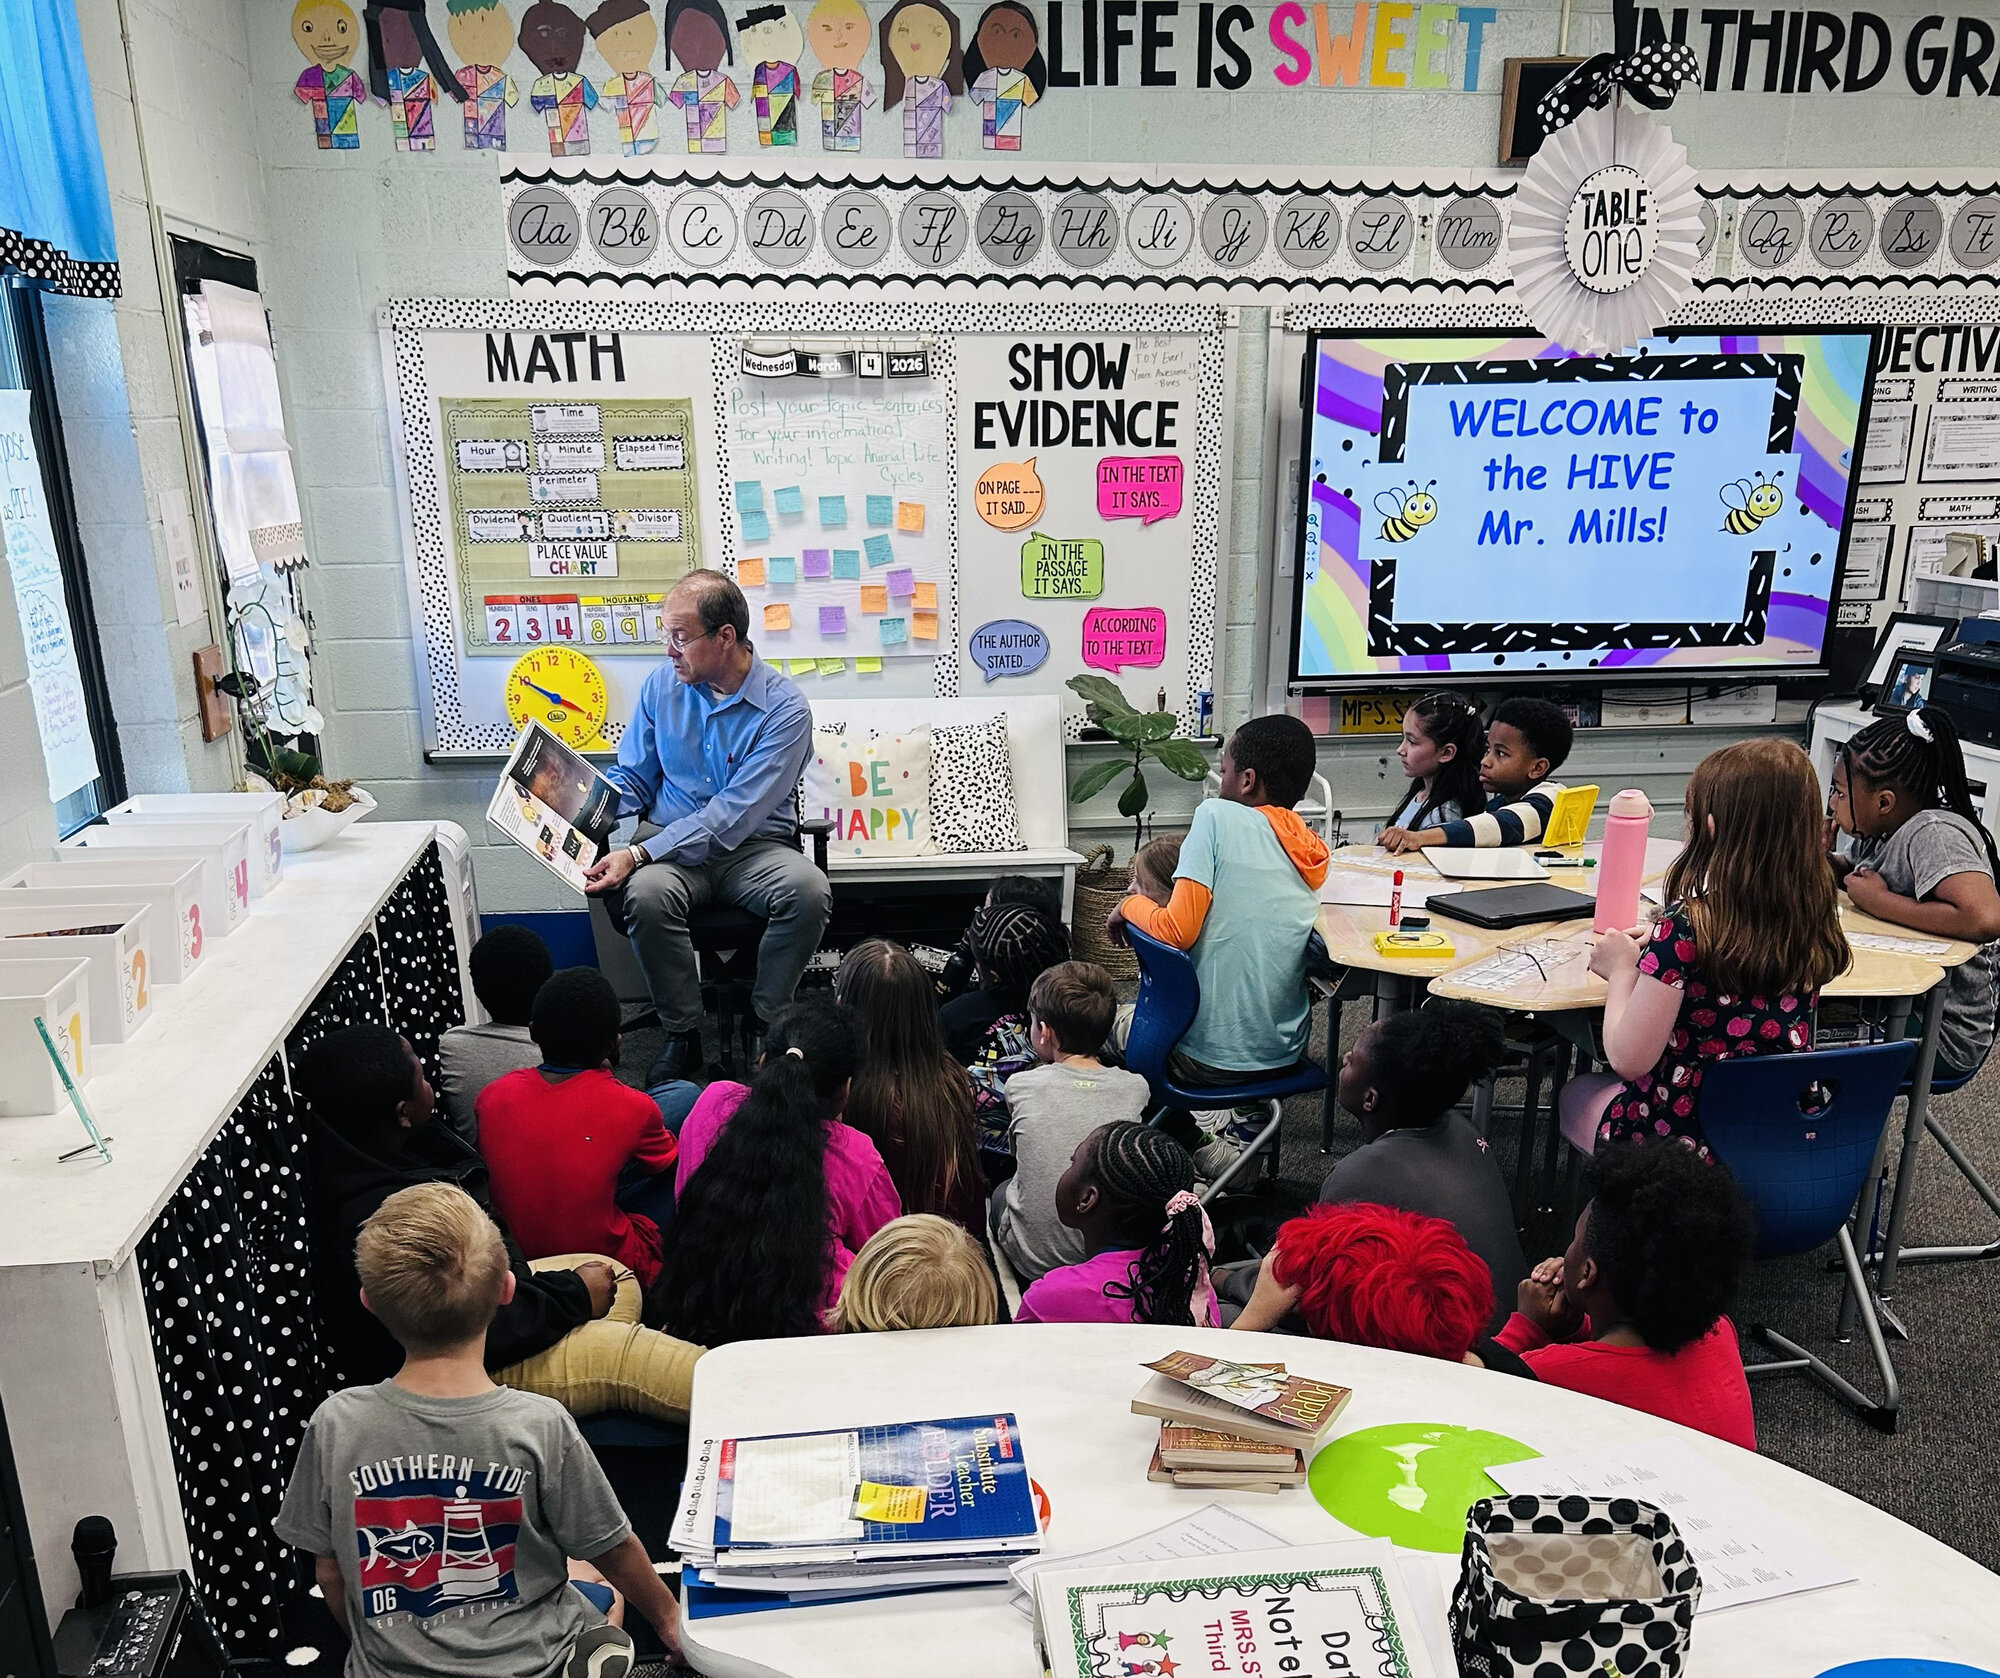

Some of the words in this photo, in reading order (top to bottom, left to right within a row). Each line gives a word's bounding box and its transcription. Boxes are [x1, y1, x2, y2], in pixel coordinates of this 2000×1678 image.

[1047, 1, 1179, 88] LIFE
[1197, 2, 1255, 90] IS
[1268, 1, 1497, 92] SWEET
[1700, 9, 1892, 94] THIRD
[1581, 188, 1648, 230] TABLE
[518, 205, 571, 247] Aa
[598, 205, 651, 248] Bb
[682, 206, 722, 248] Cc
[752, 208, 806, 249] Dd
[837, 207, 877, 249] Ee
[913, 206, 958, 263] Ff
[980, 208, 1037, 261] Gg
[1060, 208, 1109, 250] Hh
[1137, 208, 1179, 250] Ii
[1218, 208, 1254, 261] Jj
[1284, 208, 1330, 250] Kk
[1356, 208, 1403, 250] Ll
[1441, 211, 1498, 249] Mm
[1748, 210, 1792, 263] Qq
[1818, 212, 1862, 251] Rr
[1887, 211, 1930, 253] Ss
[1965, 214, 1997, 252] Tt
[1582, 226, 1643, 277] one
[485, 332, 626, 383] MATH
[744, 357, 795, 374] Wednesday
[808, 359, 842, 372] March
[867, 358, 875, 371] 4
[890, 358, 925, 372] 2026
[1008, 341, 1131, 391] SHOW
[1873, 325, 2000, 374] JECTIV
[1962, 386, 1998, 394] WRITING
[560, 407, 584, 417] Time
[731, 387, 769, 417] Post
[776, 398, 820, 429] your
[823, 389, 868, 430] topic
[974, 399, 1180, 450] EVIDENCE
[1449, 396, 1663, 439] WELCOME
[1680, 400, 1719, 435] to
[471, 446, 496, 455] Hour
[559, 444, 593, 454] Minute
[618, 444, 656, 453] Elapsed
[658, 442, 680, 451] Time
[735, 420, 759, 442] for
[768, 428, 798, 454] your
[820, 445, 856, 474] Topic
[864, 442, 908, 466] Animal
[1102, 467, 1119, 484] IN
[1121, 466, 1146, 483] THE
[1148, 465, 1179, 483] TEXT
[1483, 457, 1547, 492] the
[1567, 451, 1676, 492] HIVE
[539, 476, 588, 485] Perimeter
[880, 466, 925, 490] Cycles
[979, 481, 995, 494] ON
[996, 481, 1021, 495] PAGE
[986, 501, 999, 515] IT
[1112, 492, 1128, 509] IT
[1853, 506, 1869, 515] ISH
[1949, 504, 1972, 513] MATH
[473, 515, 516, 524] Dividend
[548, 513, 593, 523] Quotient
[637, 513, 673, 522] Divisor
[1477, 509, 1545, 547] Mr.
[1568, 505, 1667, 544] Mills!
[537, 545, 571, 559] PLACE
[575, 545, 608, 559] VALUE
[550, 561, 597, 575] CHART
[1041, 544, 1059, 560] IN
[1061, 543, 1084, 560] THE
[1036, 560, 1088, 577] PASSAGE
[602, 595, 650, 604] THOUSANDS
[1034, 578, 1050, 594] IT
[495, 618, 511, 642] 2
[526, 617, 542, 641] 3
[556, 616, 574, 640] 4
[620, 617, 638, 640] 9
[1092, 617, 1157, 634] ACCORDING
[1837, 608, 1857, 619] lies
[591, 619, 606, 642] 8
[978, 635, 998, 649] THE
[1000, 633, 1040, 649] AUTHOR
[547, 655, 559, 666] 12
[570, 658, 575, 669] 1
[1086, 640, 1101, 656] TO
[1102, 640, 1125, 656] THE
[518, 675, 531, 686] 10
[530, 661, 541, 672] 11
[584, 672, 591, 683] 2
[513, 694, 521, 704] 9
[592, 693, 599, 703] 3
[522, 713, 528, 724] 8
[574, 725, 581, 736] 5
[586, 711, 593, 722] 4
[849, 760, 893, 797] BE
[823, 808, 919, 841] HAPPY
[270, 826, 281, 874] 5
[235, 858, 248, 909] 4
[182, 912, 192, 969] GROUP
[189, 904, 202, 959] 3
[123, 962, 134, 1024] GROUP
[132, 949, 147, 1012] 2
[68, 1012, 83, 1078] 1
[1267, 1380, 1347, 1429] POPPY
[349, 1453, 474, 1496] SOUTHERN
[484, 1461, 533, 1495] TIDE
[921, 1429, 958, 1520] FOLDER
[973, 1427, 1000, 1495] Substitute
[955, 1450, 980, 1508] Teacher
[372, 1587, 397, 1614] 06
[1204, 1619, 1231, 1672] Third
[1265, 1597, 1313, 1678] Note
